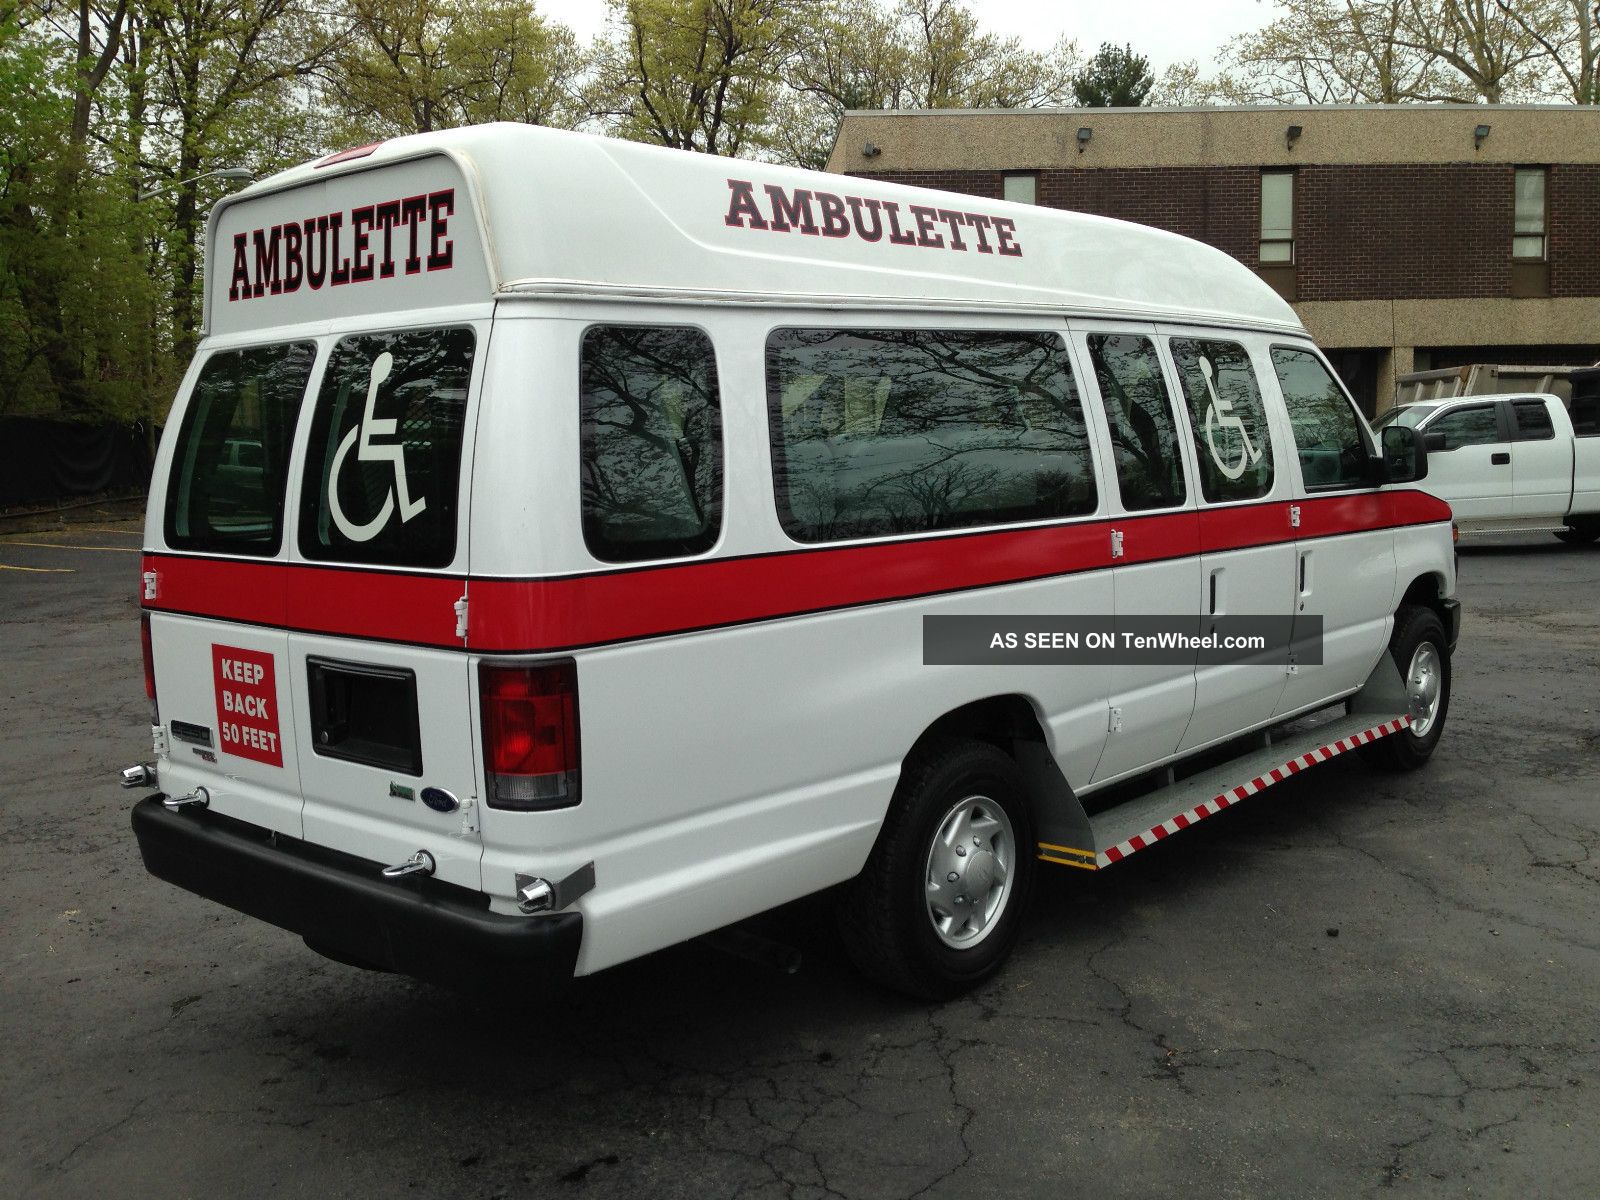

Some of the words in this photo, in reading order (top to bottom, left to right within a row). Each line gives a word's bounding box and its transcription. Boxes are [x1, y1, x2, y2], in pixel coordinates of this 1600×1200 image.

[725, 179, 1023, 258] AMBULETTE
[228, 188, 455, 302] AMBULETTE
[221, 658, 264, 684] KEEP
[222, 690, 268, 719] BACK
[222, 722, 239, 743] 50
[242, 726, 276, 752] FEET
